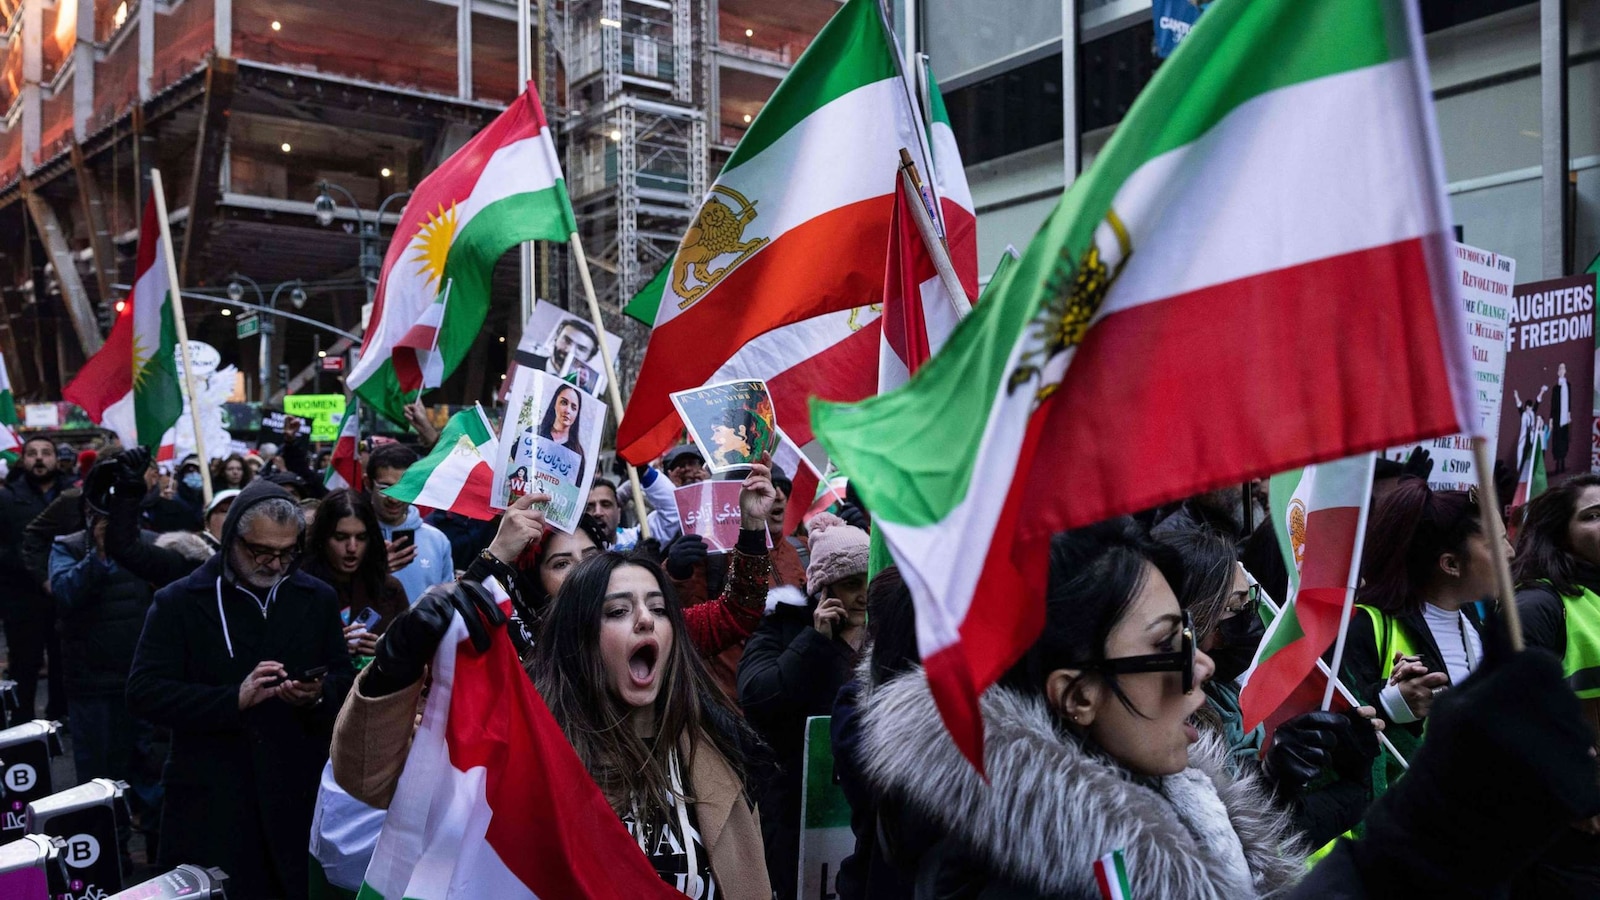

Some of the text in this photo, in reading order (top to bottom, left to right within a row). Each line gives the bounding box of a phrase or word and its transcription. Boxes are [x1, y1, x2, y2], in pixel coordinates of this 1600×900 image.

[1497, 259, 1511, 272] FOR
[1462, 270, 1509, 297] REVOLUTION
[1476, 300, 1507, 321] CHANGE
[1508, 284, 1593, 325] AUGHTERS
[1506, 326, 1517, 353] F
[1520, 313, 1593, 351] FREEDOM
[1472, 345, 1488, 362] KILL
[1475, 371, 1500, 384] TESTING
[292, 400, 337, 409] WOMEN
[1433, 437, 1452, 449] FIRE
[1442, 458, 1471, 474] & STOP
[536, 470, 560, 487] UNITED
[13, 769, 30, 786] B
[72, 841, 92, 862] B
